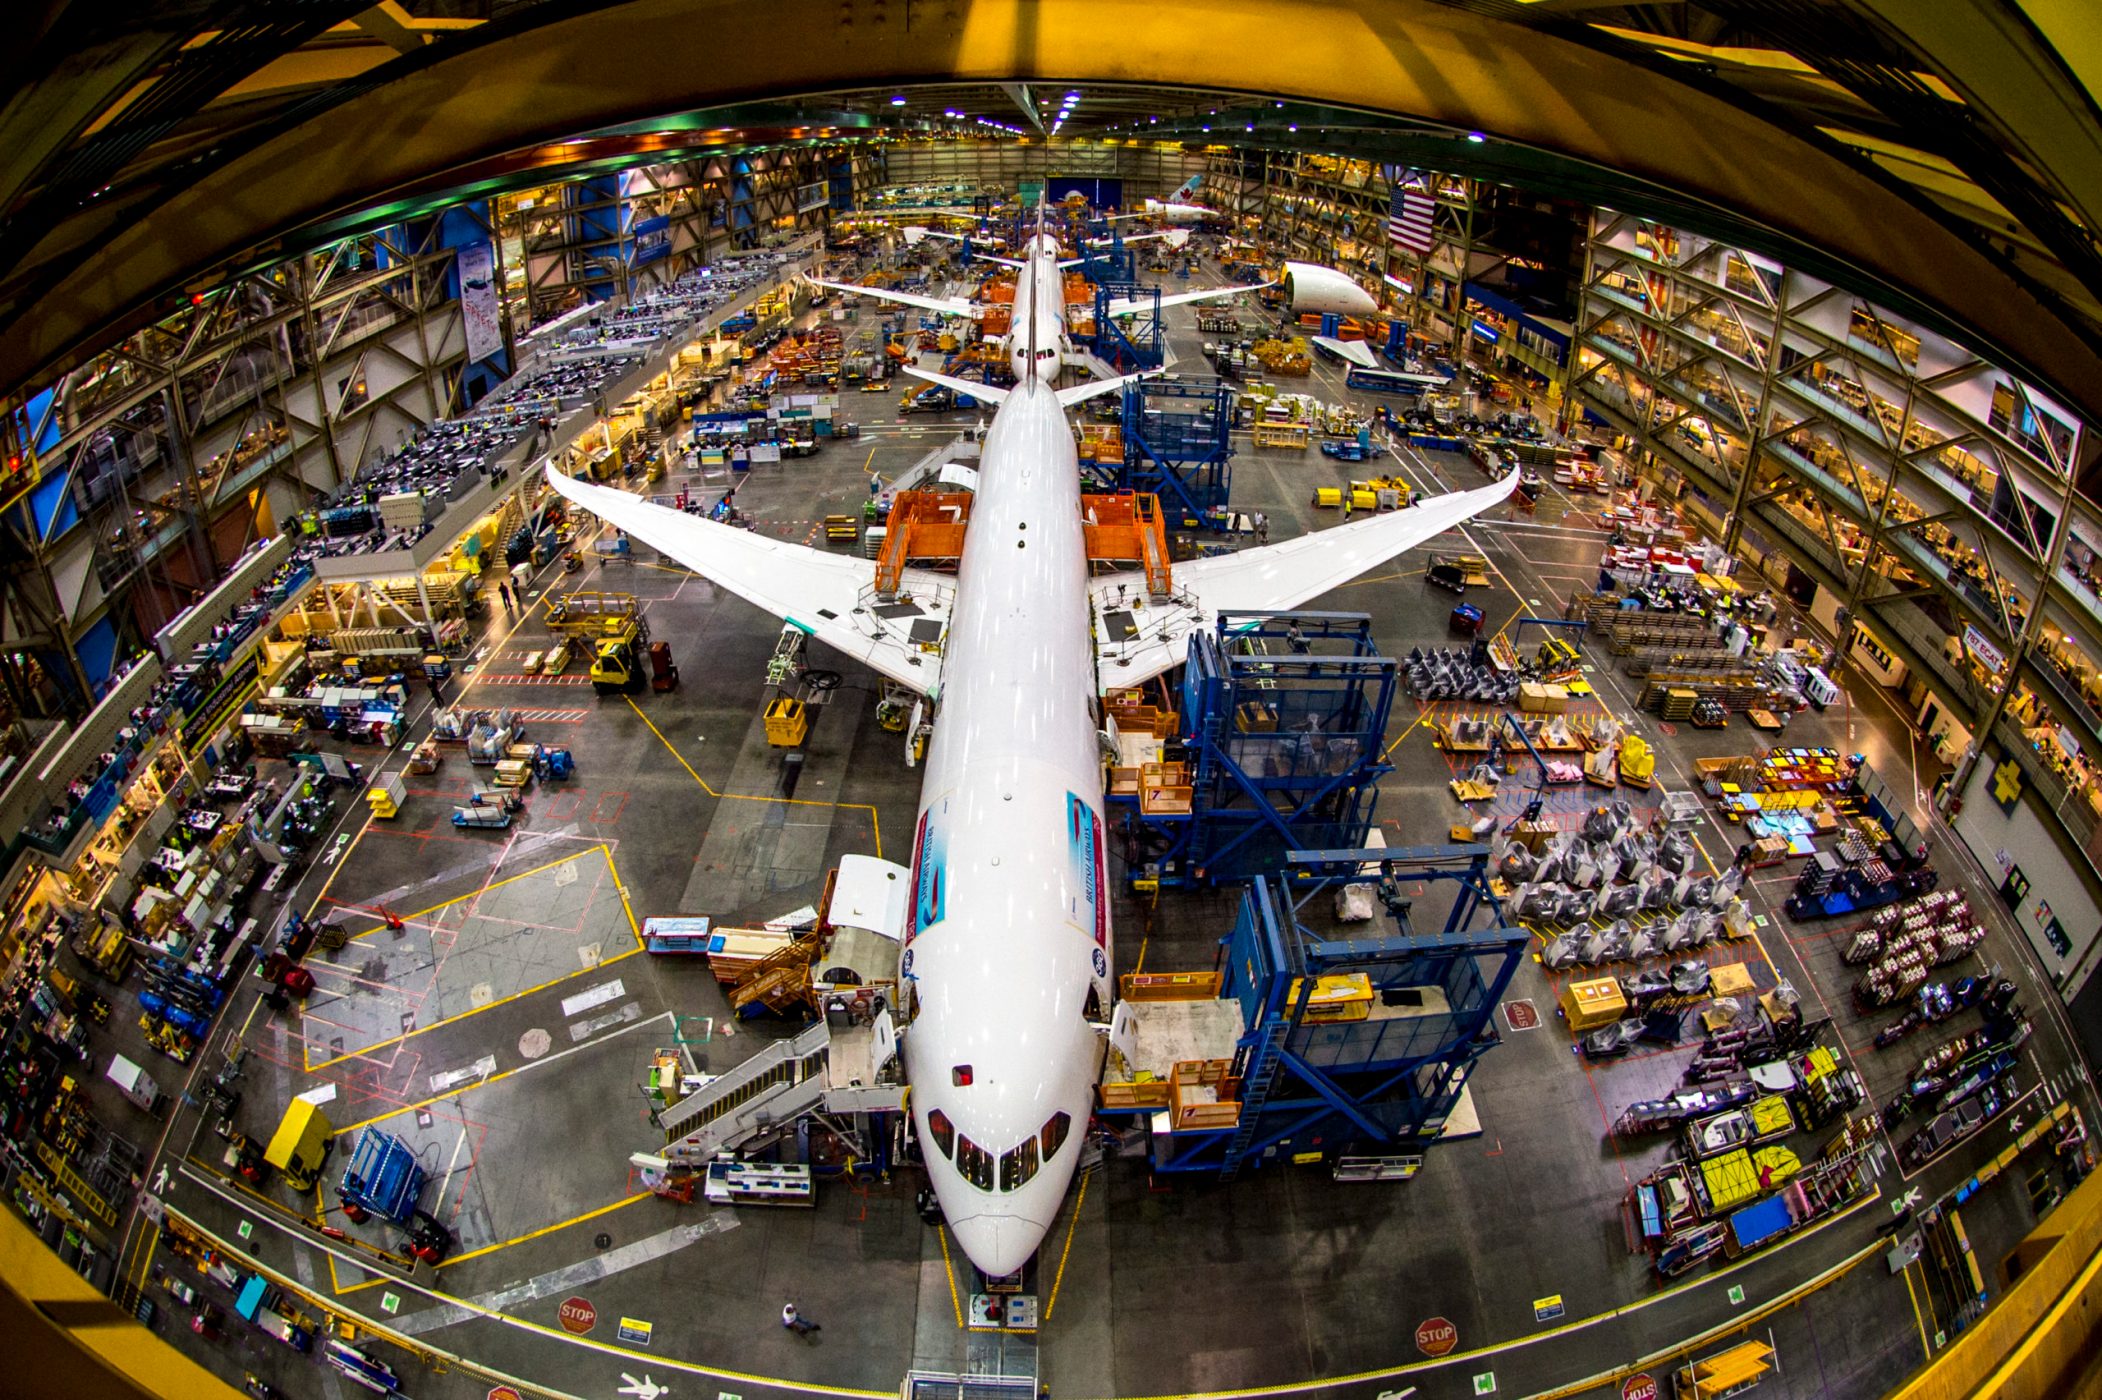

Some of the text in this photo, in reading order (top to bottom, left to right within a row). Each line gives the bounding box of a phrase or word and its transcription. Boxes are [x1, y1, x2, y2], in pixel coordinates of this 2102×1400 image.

[1967, 631, 1999, 666] 787 ECAT
[184, 712, 207, 739] Boeing
[205, 680, 234, 714] Industrial
[1152, 791, 1161, 800] 7
[923, 826, 934, 862] BRITISH
[920, 863, 930, 903] AIRWAYS
[1084, 827, 1095, 904] BRITISH AIRWAYS
[1512, 1004, 1529, 1028] STOP
[561, 1304, 594, 1322] STOP
[1418, 1326, 1453, 1344] STOP
